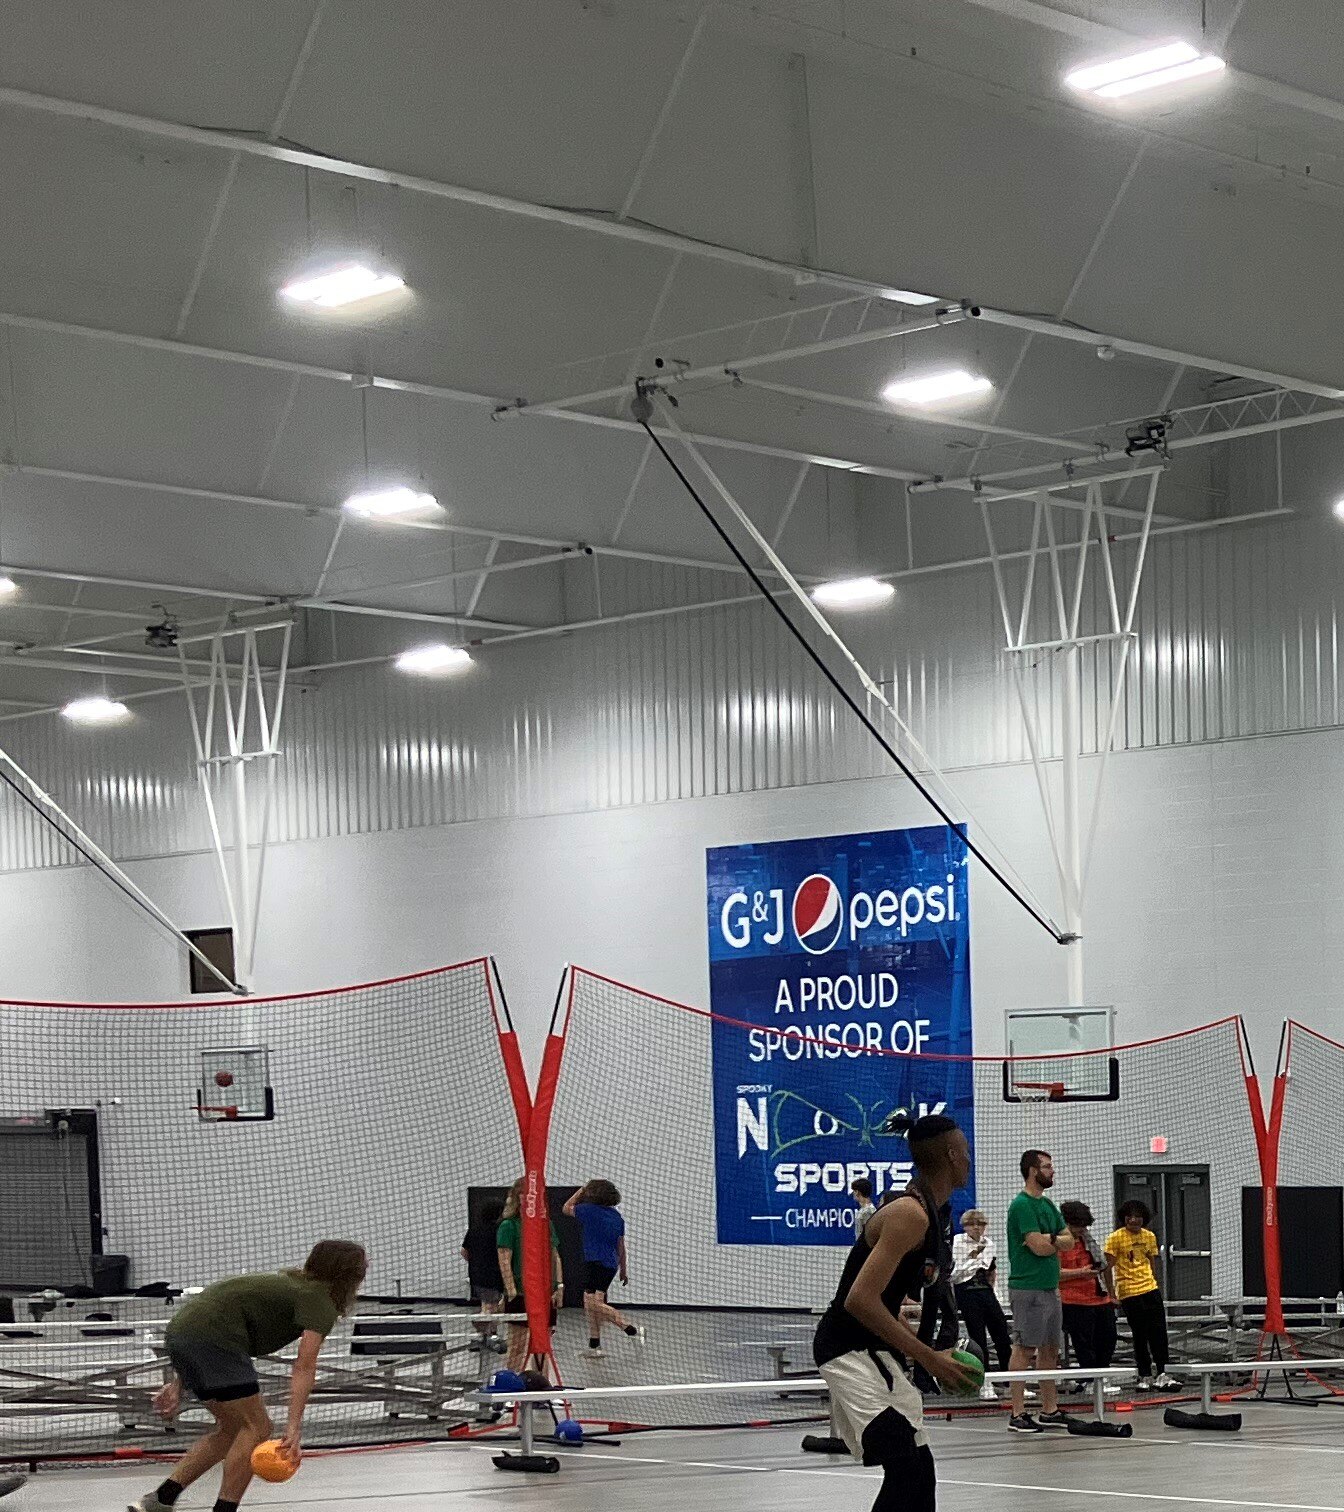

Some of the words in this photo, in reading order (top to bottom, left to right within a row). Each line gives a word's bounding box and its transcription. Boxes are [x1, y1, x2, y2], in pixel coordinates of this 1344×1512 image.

[720, 888, 785, 948] G&J
[849, 873, 956, 941] pepsi
[774, 979, 795, 1014] A
[799, 973, 899, 1012] PROUD
[749, 1021, 884, 1062] SPONSOR
[890, 1019, 931, 1055] OF
[773, 1161, 915, 1197] SPORTS
